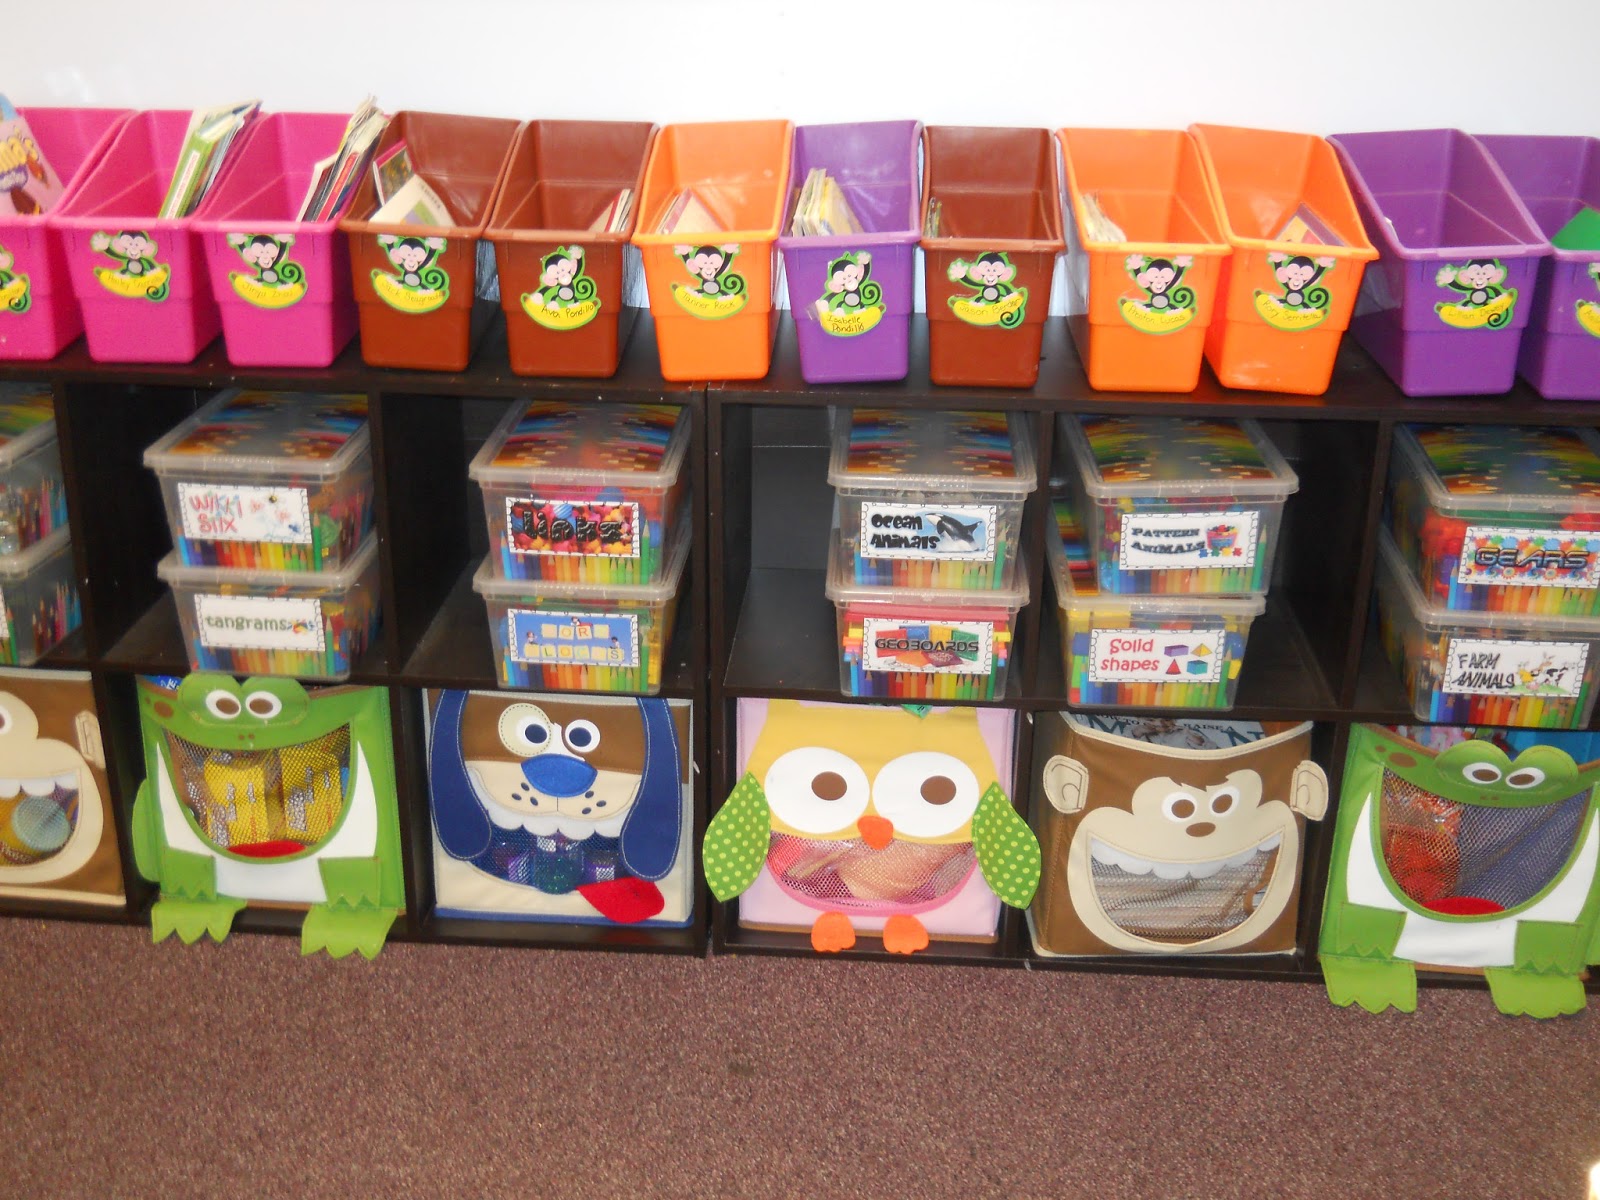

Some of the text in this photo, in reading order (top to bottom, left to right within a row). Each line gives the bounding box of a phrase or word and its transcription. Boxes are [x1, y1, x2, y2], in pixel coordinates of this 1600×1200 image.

[870, 513, 923, 530] Ocean
[1130, 527, 1201, 539] PATTERN
[1131, 541, 1206, 555] ANIMALS
[1474, 546, 1590, 569] GEARS
[205, 615, 287, 632] tangrams
[874, 637, 980, 653] GEOBOARDS
[1109, 638, 1154, 655] Solid
[1101, 657, 1160, 673] shapes
[1457, 652, 1501, 670] FARM
[1452, 671, 1516, 689] ANIMALS
